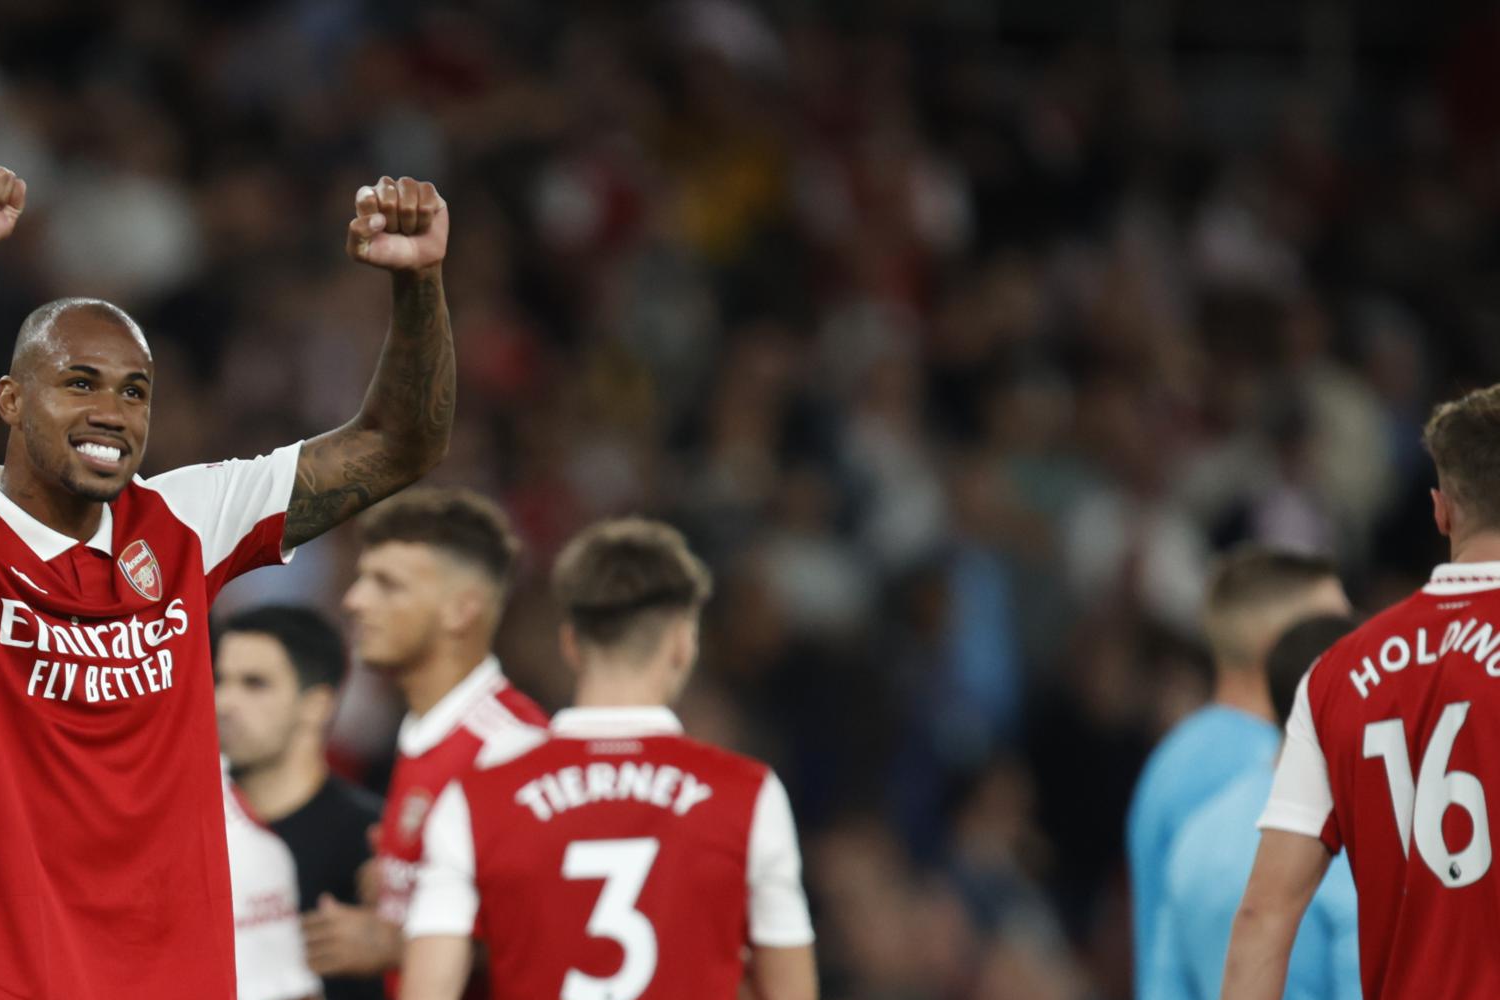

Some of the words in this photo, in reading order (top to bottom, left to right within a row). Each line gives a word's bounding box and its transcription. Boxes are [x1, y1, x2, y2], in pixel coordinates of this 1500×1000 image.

[125, 545, 151, 571] Arsenal
[0, 597, 188, 660] Emirates
[27, 659, 78, 701] FLY
[85, 649, 173, 703] BETTER
[514, 760, 714, 822] TIERNEY
[1363, 701, 1492, 888] 16
